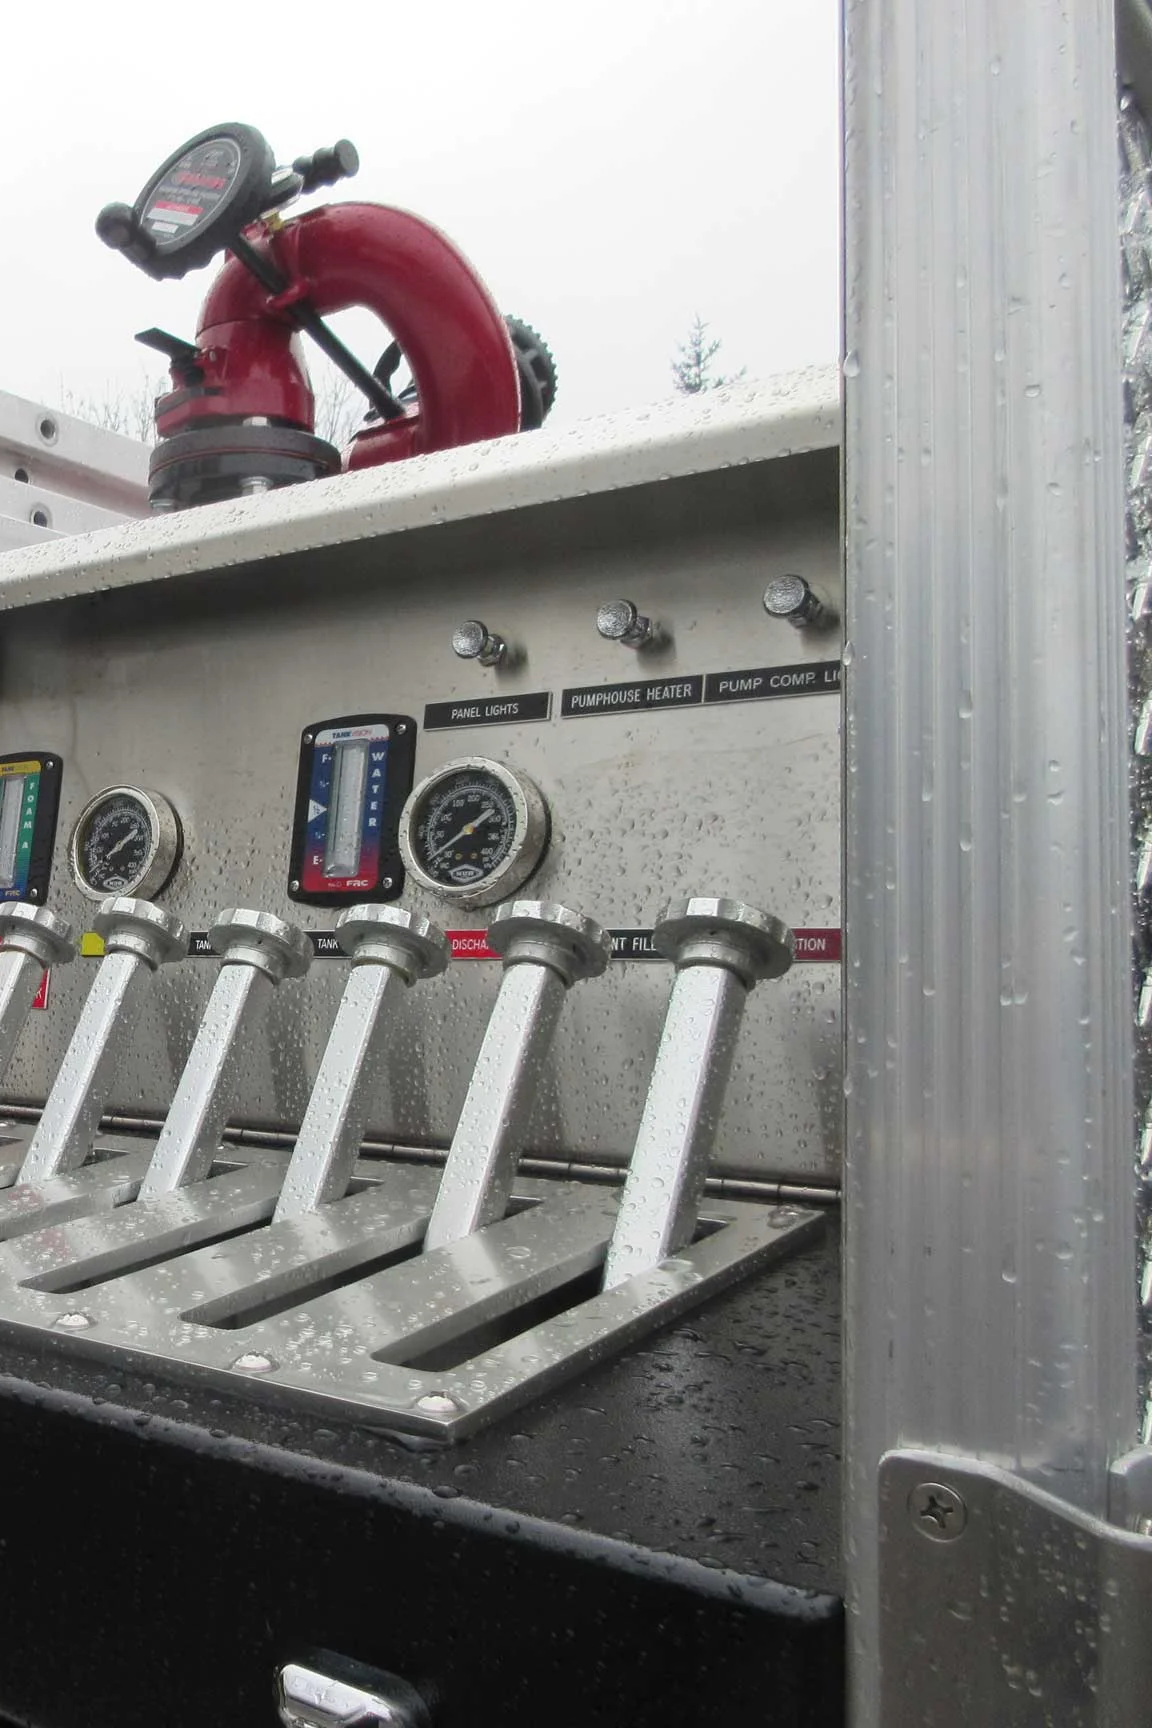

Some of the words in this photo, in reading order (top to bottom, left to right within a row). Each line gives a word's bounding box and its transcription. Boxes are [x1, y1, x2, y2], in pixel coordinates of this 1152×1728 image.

[719, 677, 763, 693] PUMP
[769, 671, 816, 688] COMP.
[571, 688, 641, 709] PUMPHOUSE
[646, 683, 692, 701] HEATER
[451, 706, 481, 720] PANEL
[485, 702, 519, 717] LIGHTS
[368, 752, 385, 827] WATER
[23, 782, 35, 829] FOAM
[318, 938, 338, 949] TANK
[452, 938, 489, 950] DISCHA
[632, 937, 657, 951] FILL
[795, 938, 826, 951] TION
